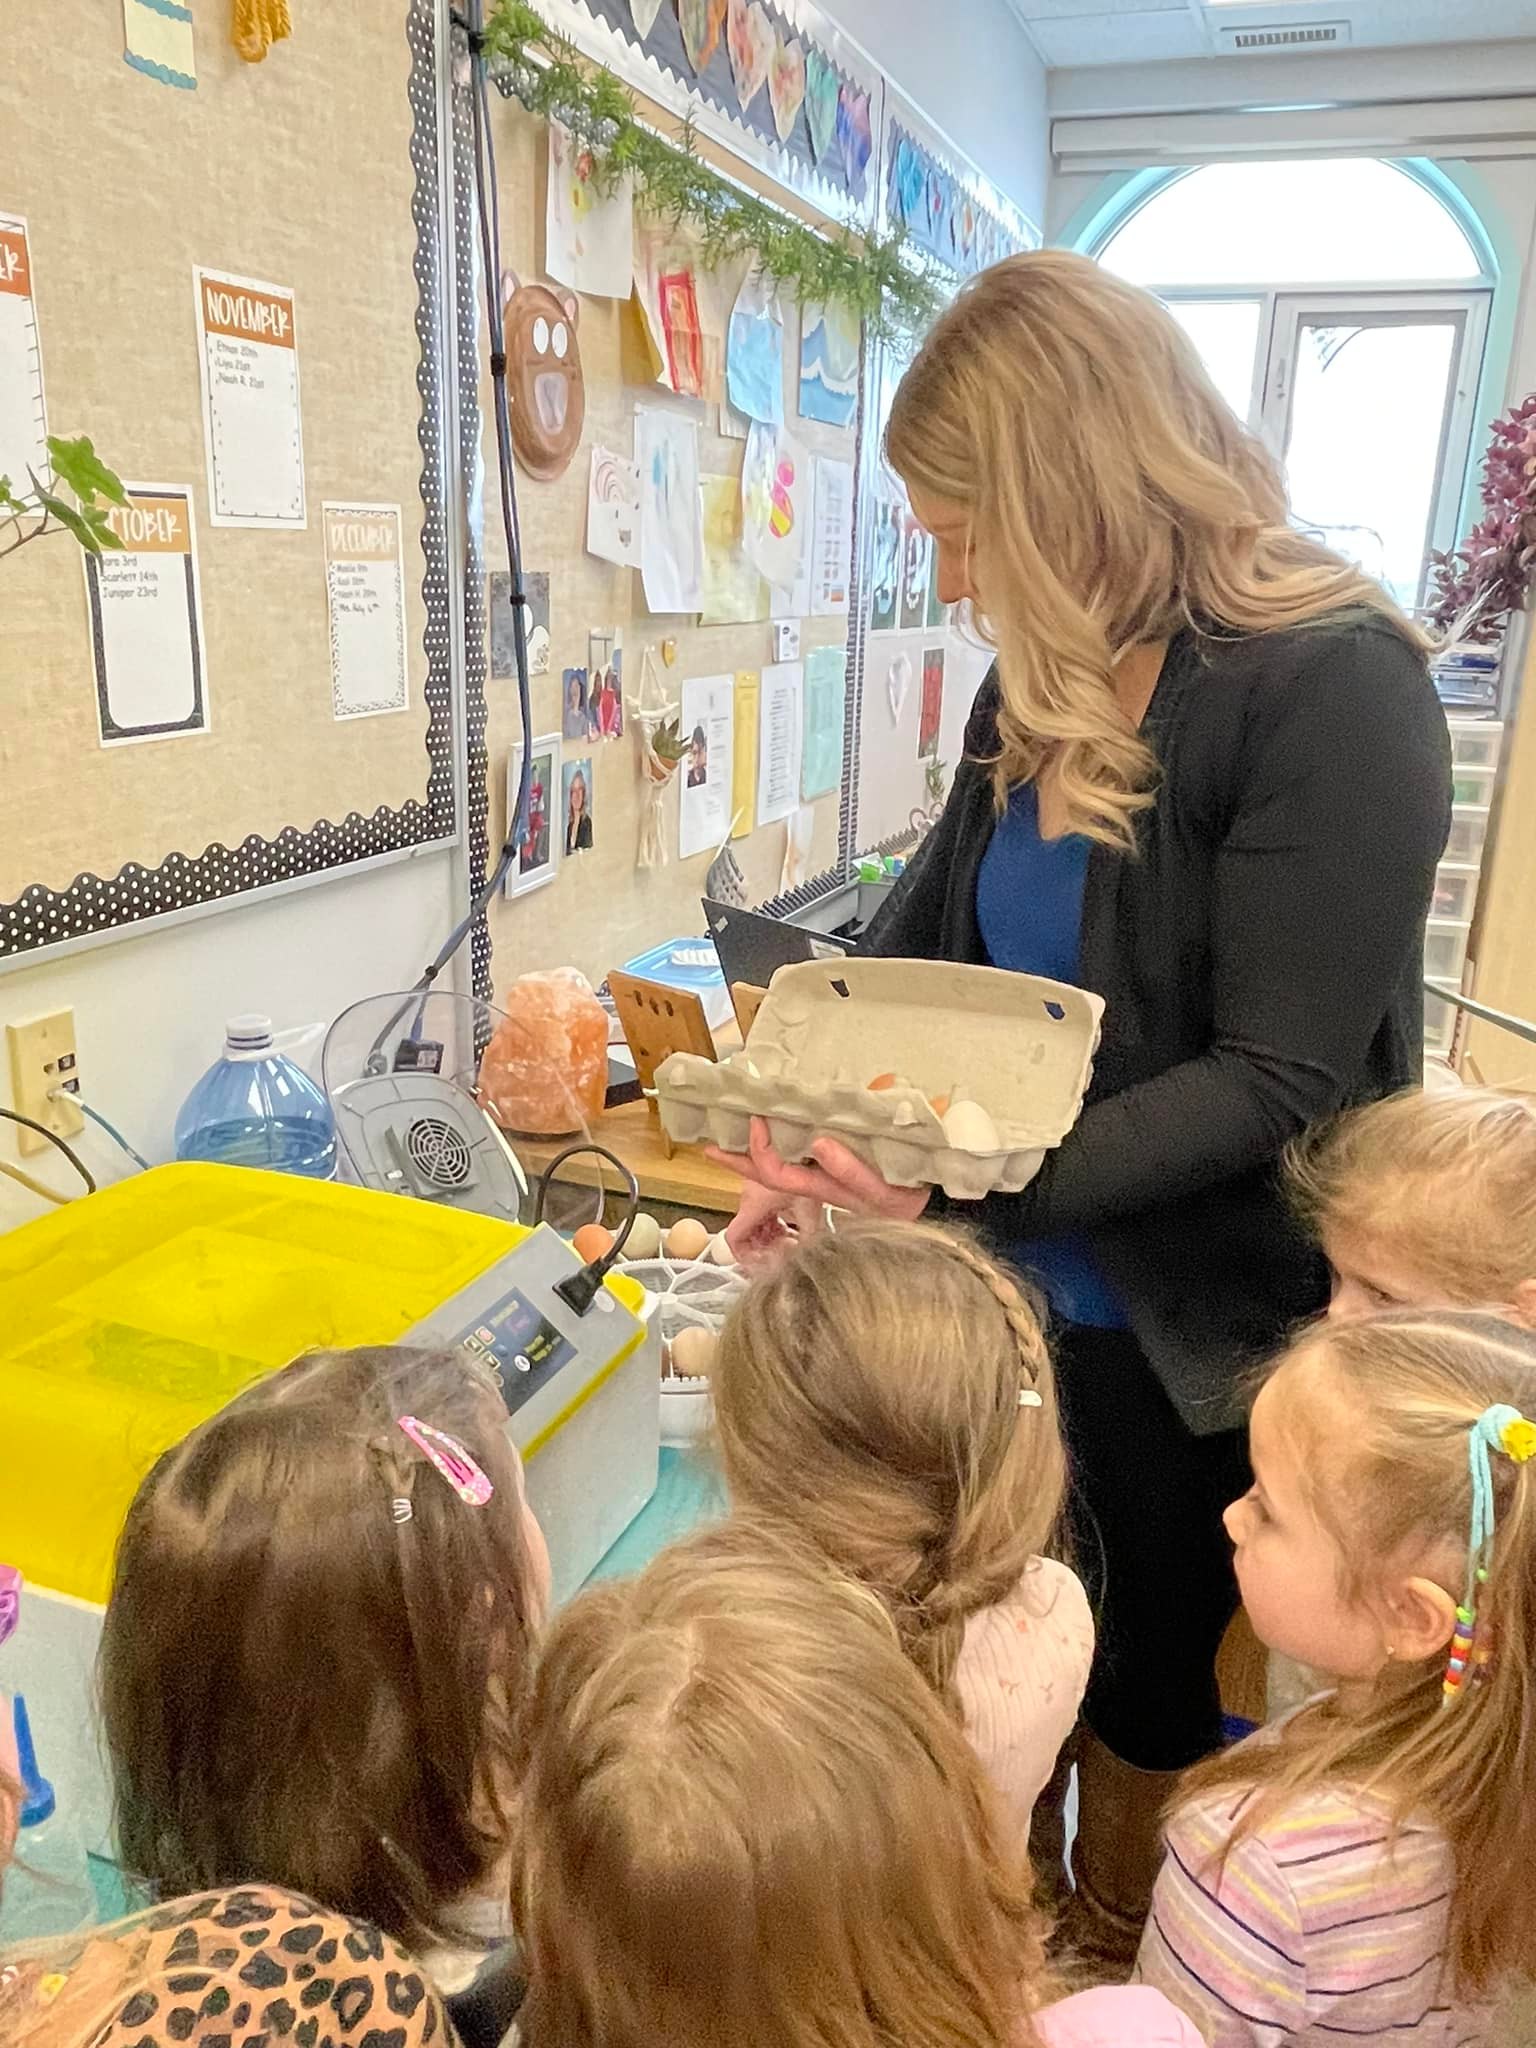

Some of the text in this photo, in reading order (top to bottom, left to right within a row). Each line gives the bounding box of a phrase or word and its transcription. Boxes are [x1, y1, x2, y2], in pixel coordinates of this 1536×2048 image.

[206, 287, 291, 338] NOVEMBER
[107, 507, 182, 543] CTOBER
[331, 523, 397, 552] DECEMBER
[122, 554, 138, 567] 3rd
[140, 571, 159, 582] 14th
[103, 586, 158, 600] Juniper 23rd
